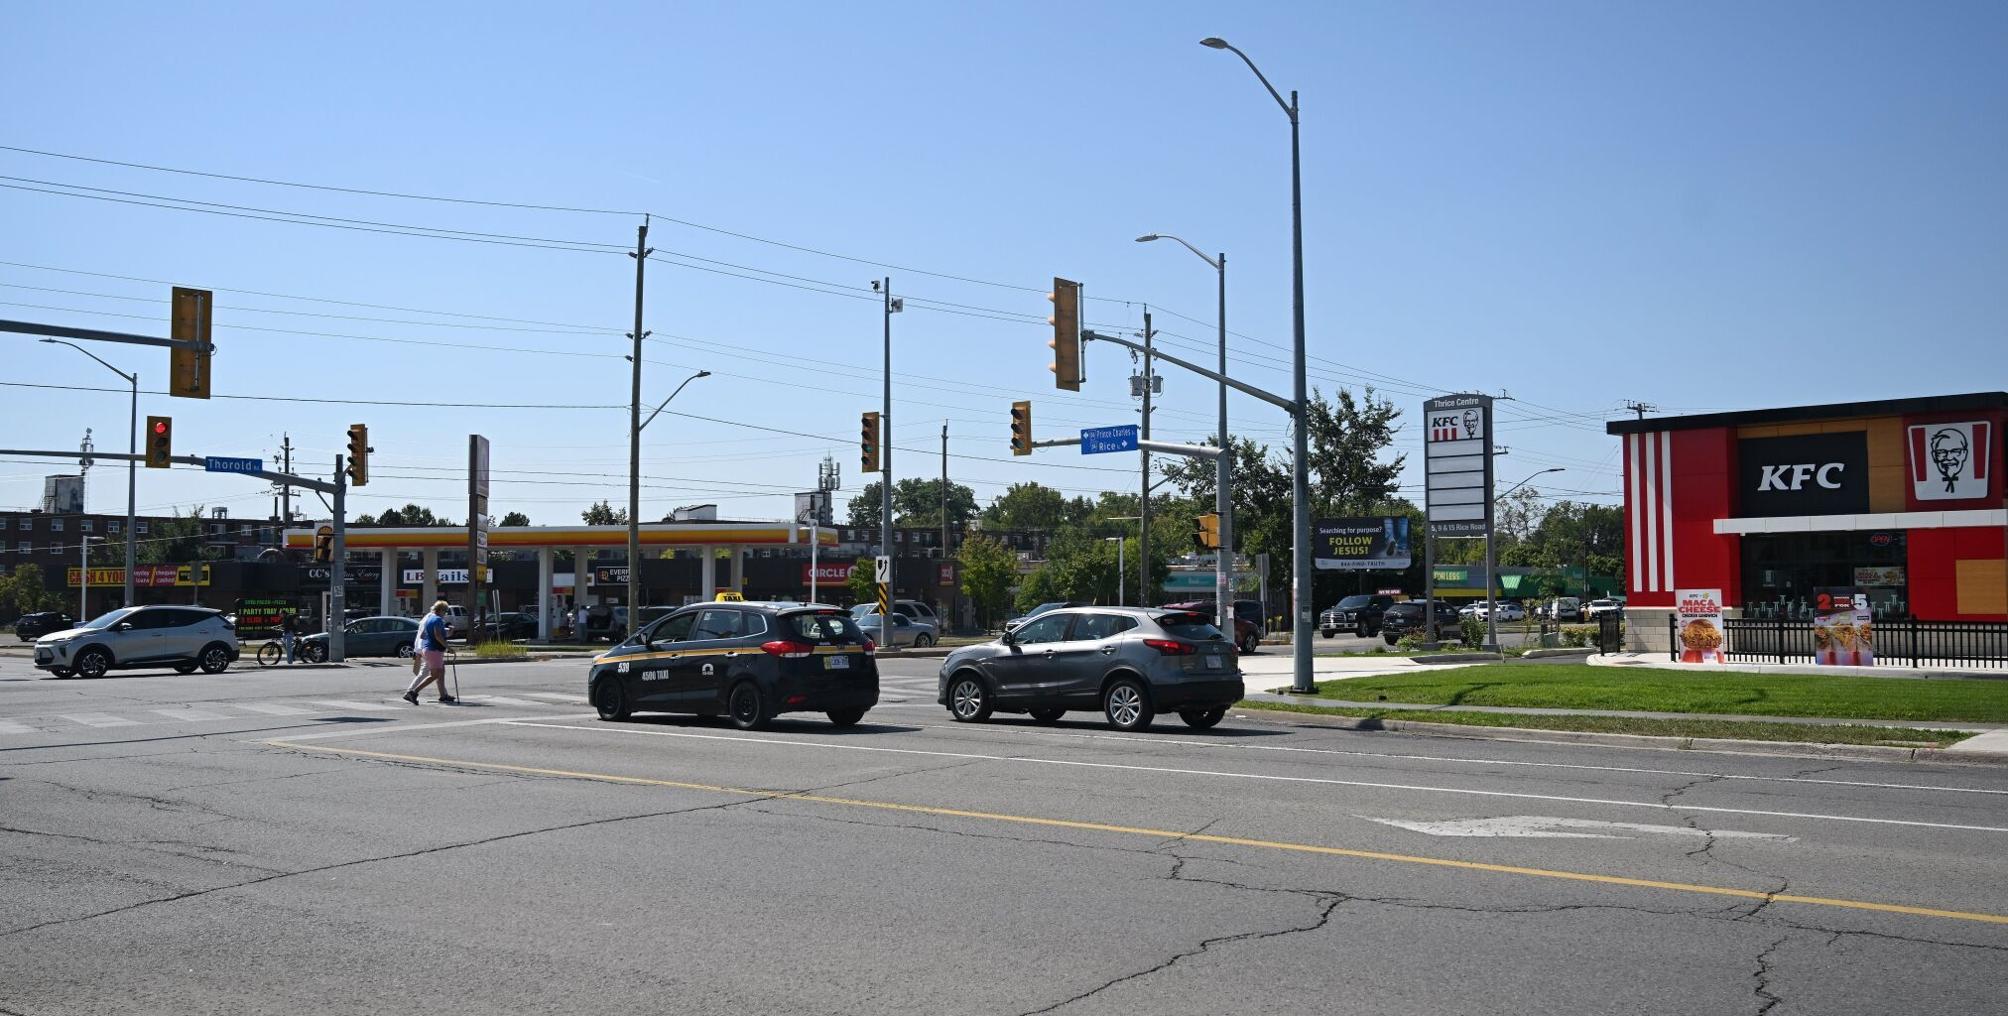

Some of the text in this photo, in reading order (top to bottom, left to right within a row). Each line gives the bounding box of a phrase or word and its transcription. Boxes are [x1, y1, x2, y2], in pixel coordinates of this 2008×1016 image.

[1434, 398, 1479, 408] Thrice Centre
[1432, 416, 1458, 427] KFC
[1099, 442, 1116, 450] Rice
[208, 458, 252, 470] Thorold
[1757, 462, 1845, 491] KFC
[1356, 526, 1382, 534] purpose?
[1329, 537, 1372, 545] FOLLOW
[1333, 546, 1368, 555] JESUS!
[309, 569, 330, 577] CC's
[438, 571, 469, 581] ails
[1817, 594, 1831, 609] 2
[657, 669, 669, 680] TAXI
